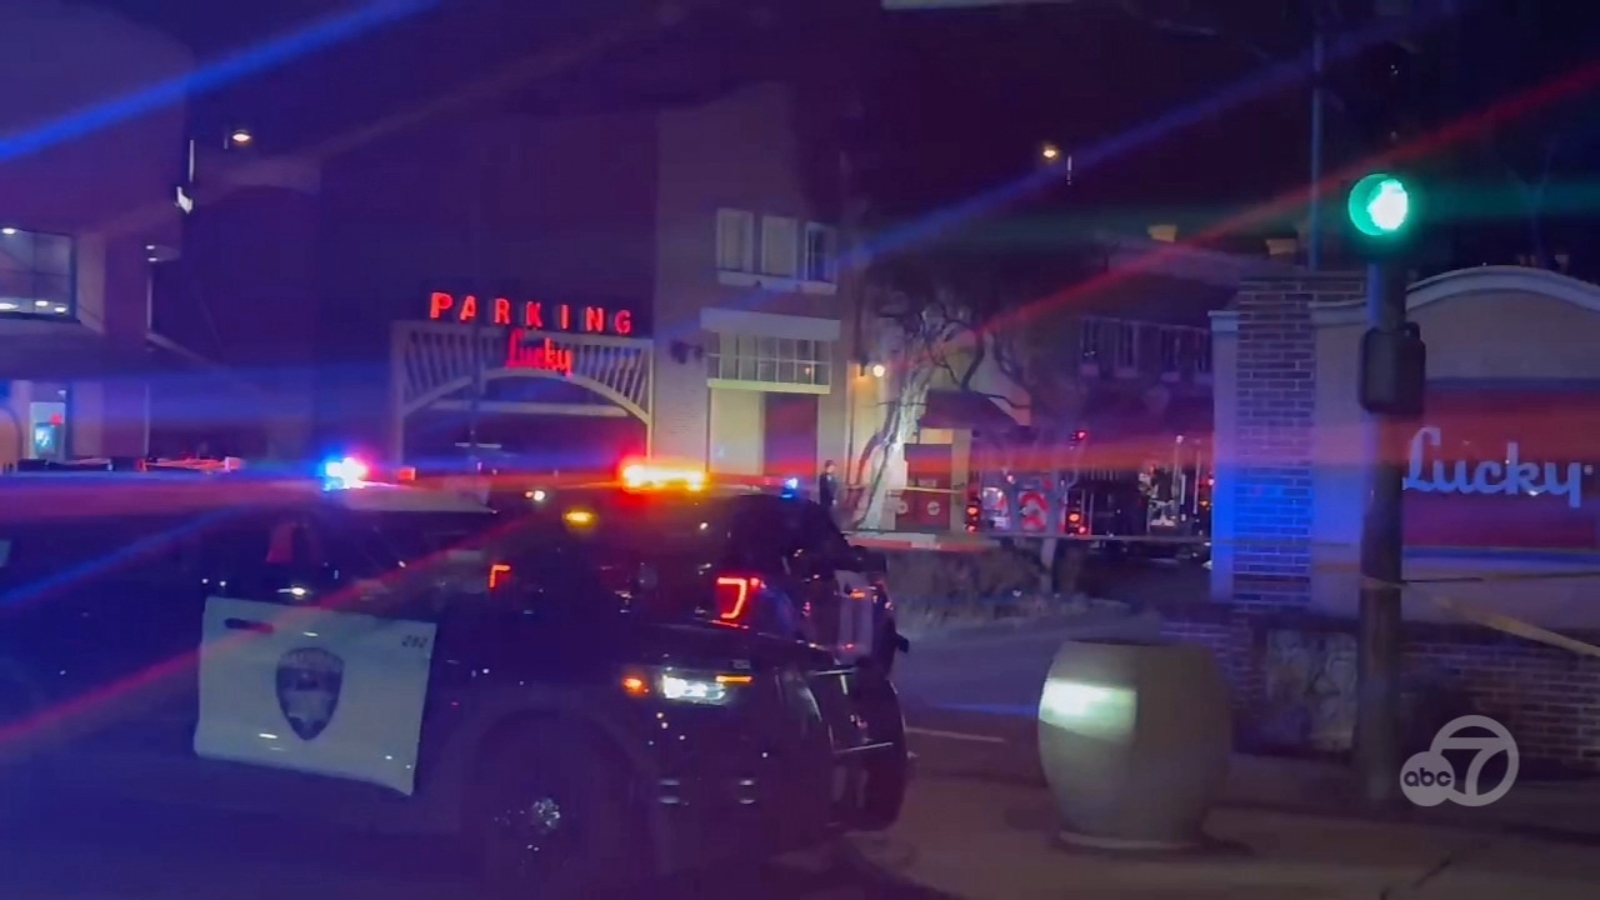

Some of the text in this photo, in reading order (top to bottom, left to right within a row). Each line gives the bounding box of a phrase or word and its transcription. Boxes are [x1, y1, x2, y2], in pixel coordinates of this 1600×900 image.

[430, 292, 631, 333] PARKING
[507, 328, 572, 378] Lucky
[1403, 426, 1581, 508] Lucky
